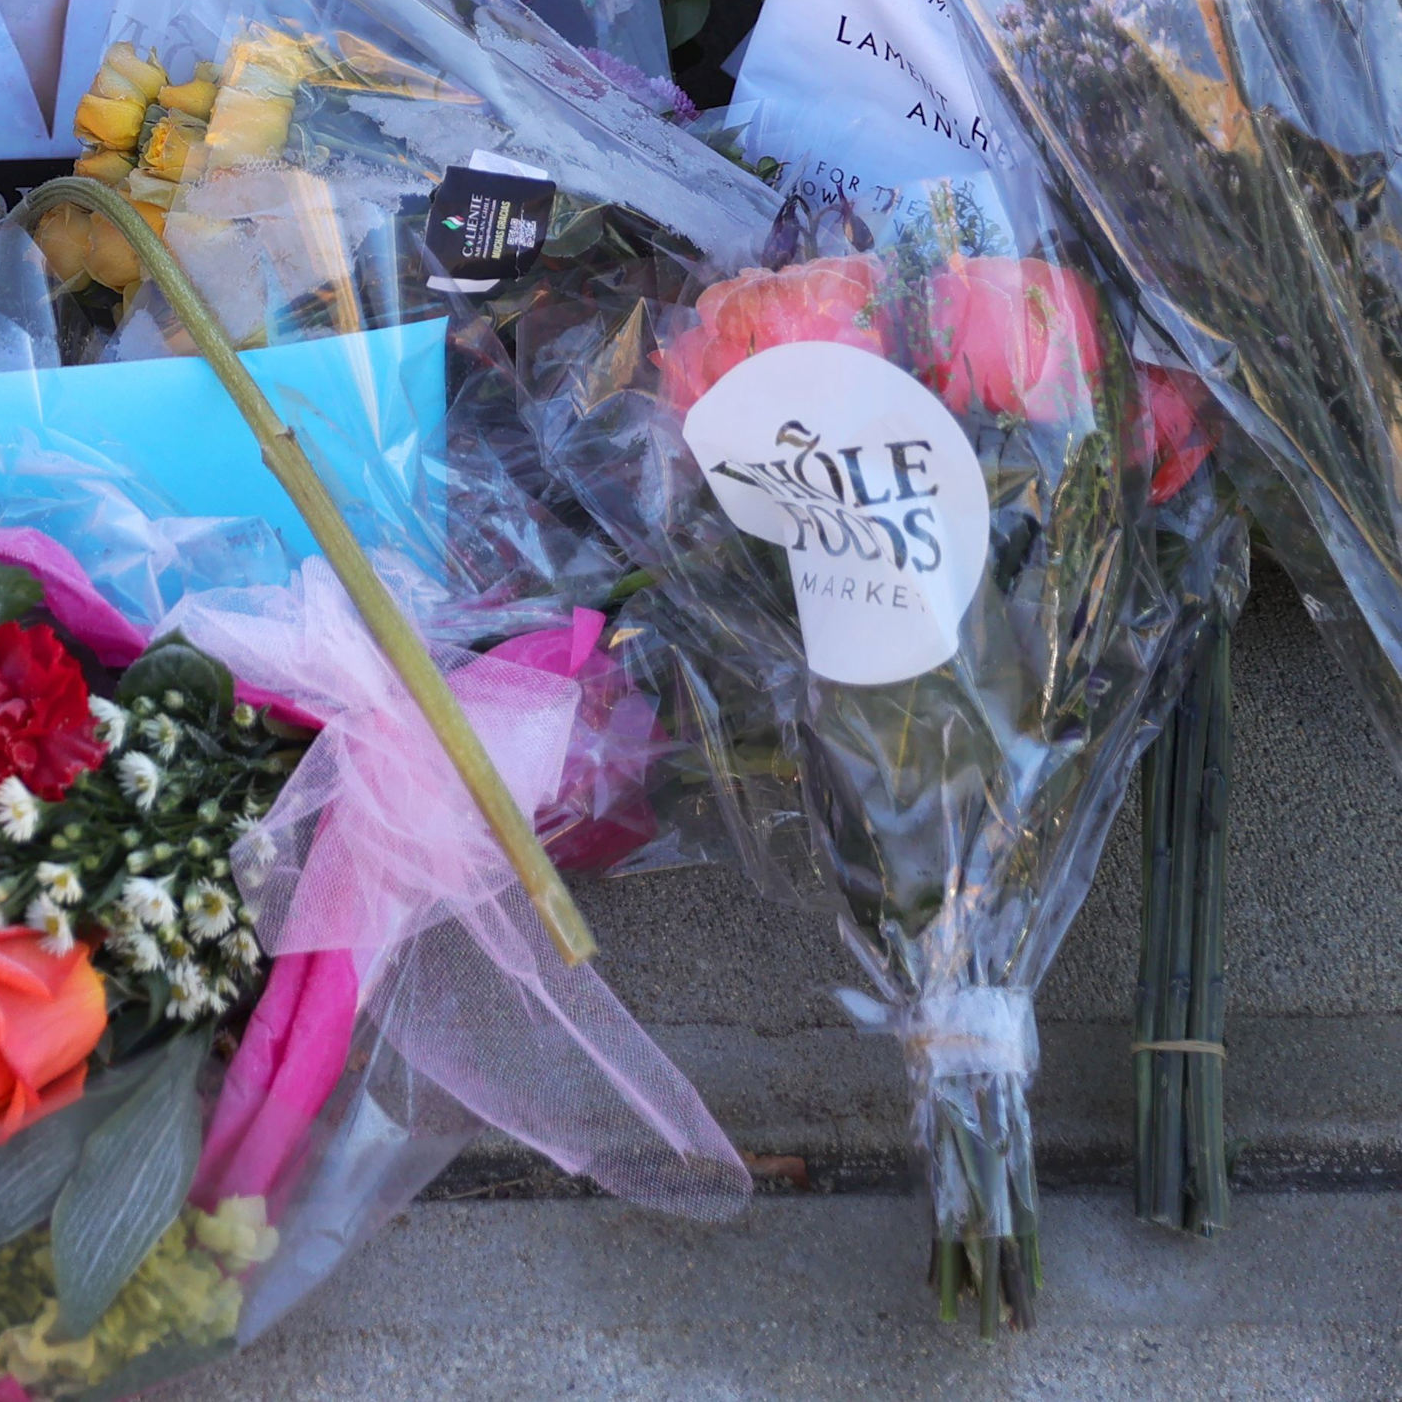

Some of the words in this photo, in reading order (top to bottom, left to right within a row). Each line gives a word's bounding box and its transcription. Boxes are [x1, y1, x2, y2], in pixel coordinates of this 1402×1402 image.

[497, 200, 511, 229] GRACIAS
[474, 220, 487, 258] MEXICAN
[491, 230, 505, 259] MUCHAS
[709, 436, 939, 508] WHOLE
[773, 500, 942, 574] FOODS
